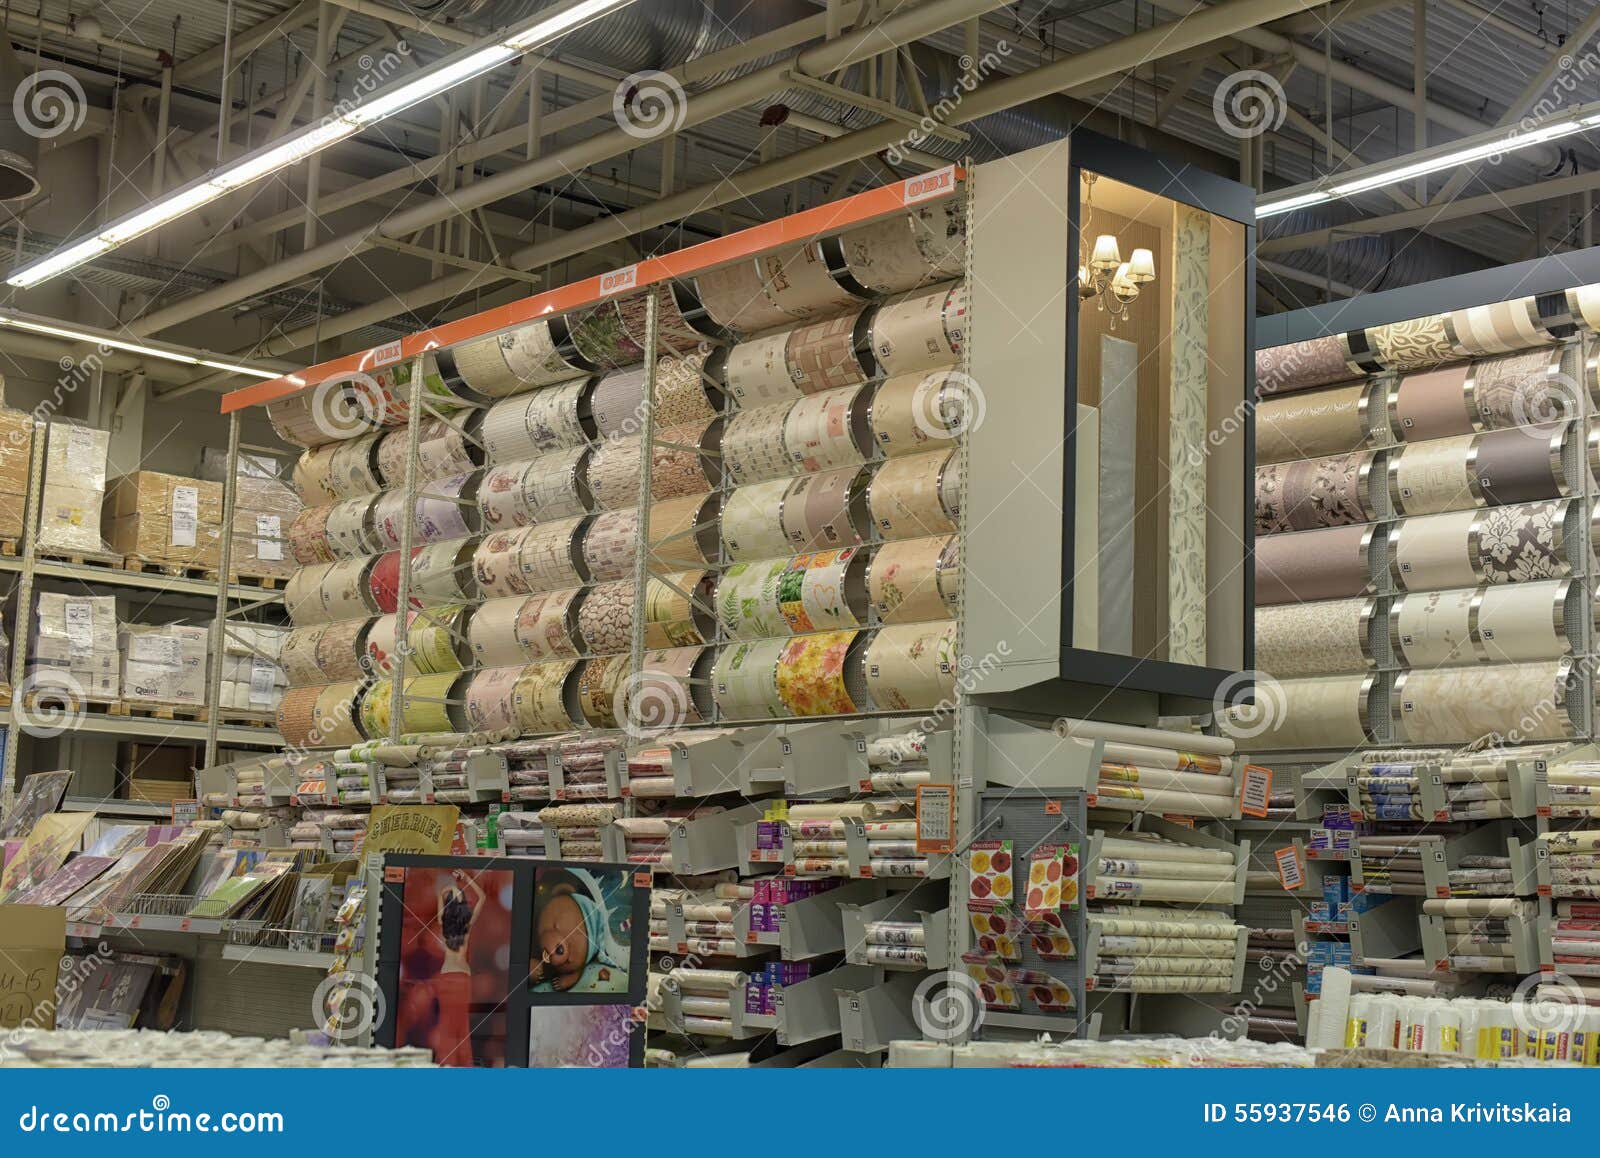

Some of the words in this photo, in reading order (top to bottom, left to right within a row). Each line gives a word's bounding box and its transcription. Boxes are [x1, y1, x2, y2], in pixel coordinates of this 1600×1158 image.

[908, 171, 952, 197] OBI
[603, 271, 633, 290] OBI
[376, 344, 400, 362] OBI
